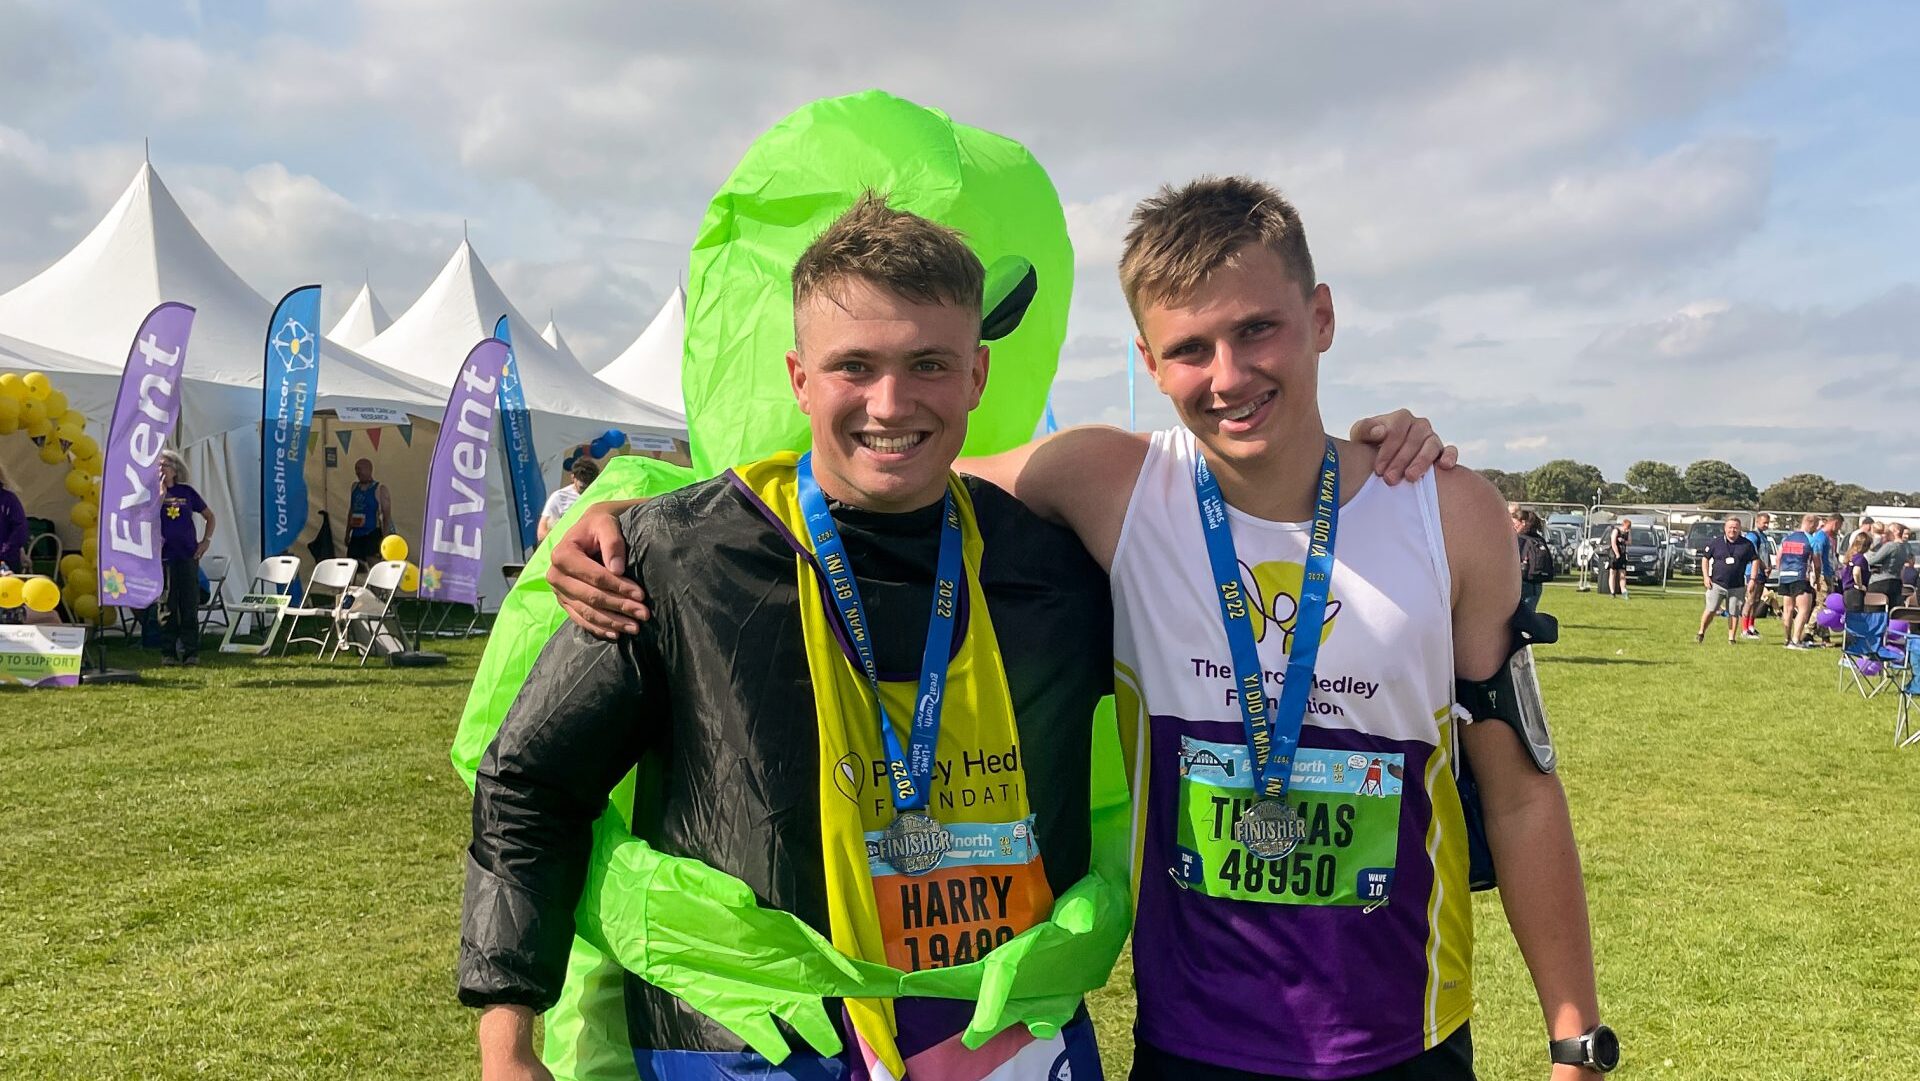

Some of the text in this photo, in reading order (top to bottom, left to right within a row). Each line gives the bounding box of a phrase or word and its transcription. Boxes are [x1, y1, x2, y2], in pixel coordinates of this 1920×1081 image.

[287, 382, 308, 462] Research
[110, 334, 181, 560] Event
[275, 376, 289, 538] Yorkshire Cancer
[433, 364, 496, 561] Event
[1318, 504, 1333, 518] IT
[1313, 520, 1332, 542] DID
[1310, 541, 1328, 557] YI
[824, 553, 846, 575] IN!
[833, 576, 853, 600] GET
[937, 579, 954, 619] 2022
[1221, 581, 1246, 619] 2022
[7, 655, 76, 667] TO SUPPORT
[859, 646, 870, 656] IT
[1191, 658, 1232, 679] The
[1243, 673, 1259, 688] YI
[924, 672, 939, 727] great north
[1226, 689, 1344, 717] Fntion
[1246, 690, 1264, 714] DID
[1250, 716, 1266, 727] IT
[890, 760, 915, 800] 2022
[1303, 776, 1327, 785] run
[875, 784, 1020, 816] FNDATI
[1211, 796, 1355, 848] THAS
[1235, 820, 1306, 841] FINISHER
[878, 831, 952, 859] FINISHER
[955, 834, 992, 848] north
[972, 849, 995, 858] run
[1184, 864, 1190, 878] C
[1219, 849, 1336, 897] 48950
[1368, 873, 1388, 883] WAVE
[1368, 884, 1384, 897] 10
[900, 876, 1013, 930] HARRY
